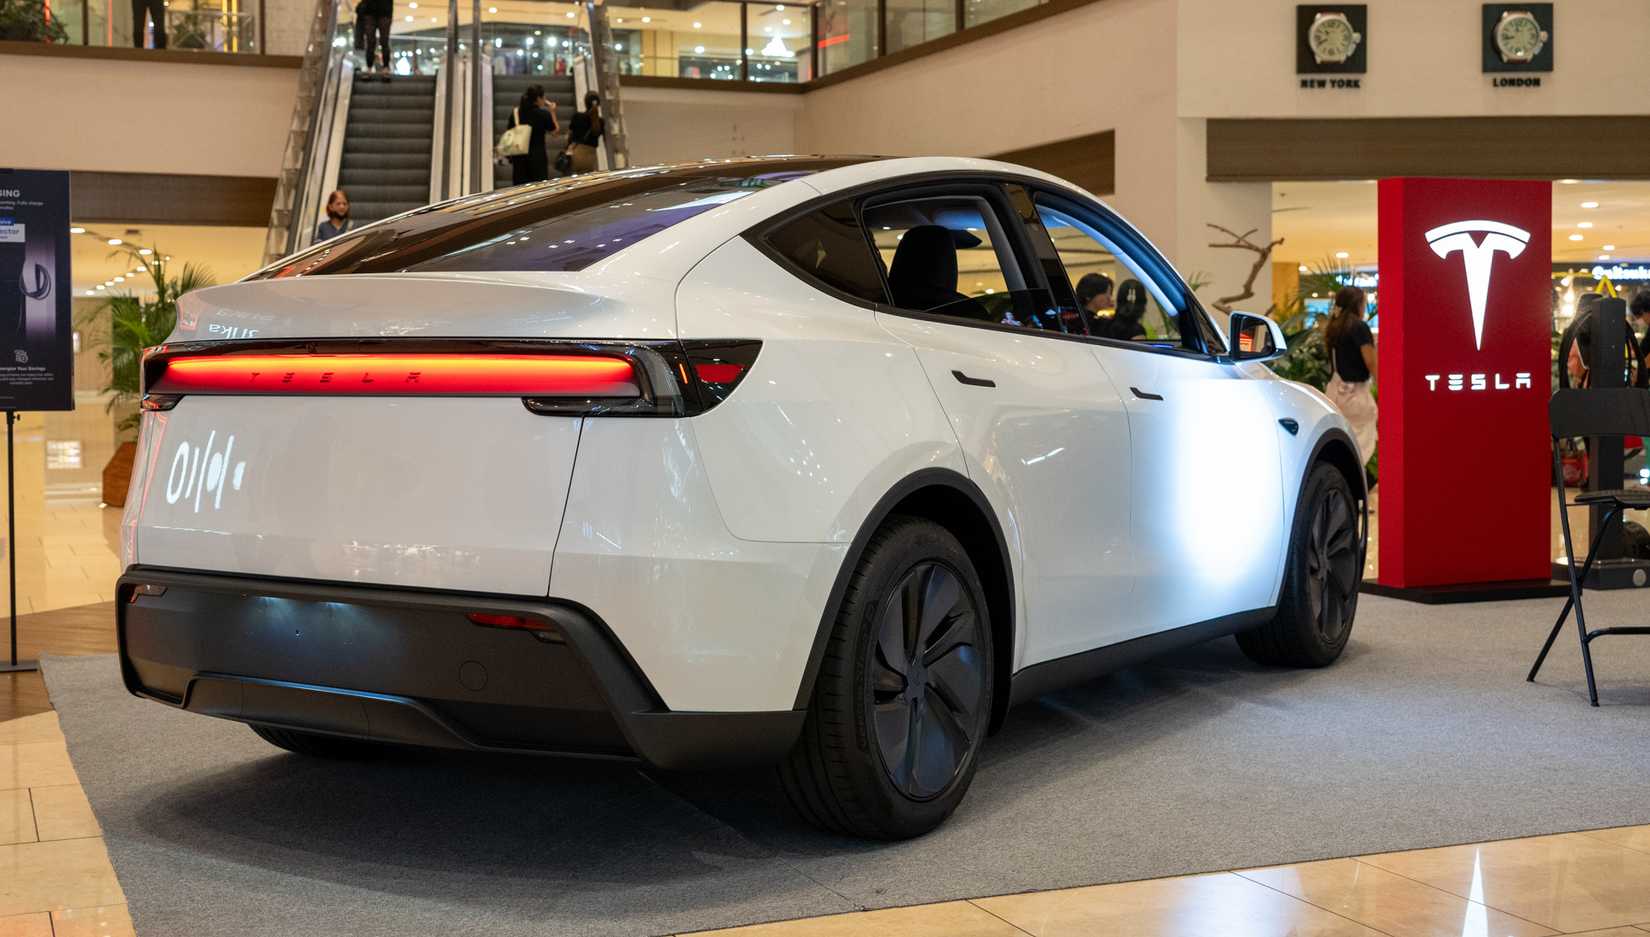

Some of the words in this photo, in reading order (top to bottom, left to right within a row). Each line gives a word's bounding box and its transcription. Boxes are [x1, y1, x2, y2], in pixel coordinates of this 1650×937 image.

[1301, 79, 1327, 88] NEW
[1329, 79, 1360, 89] YORK
[1492, 78, 1541, 87] LONDON
[250, 371, 421, 384] TESLA
[1424, 372, 1531, 391] TESLA
